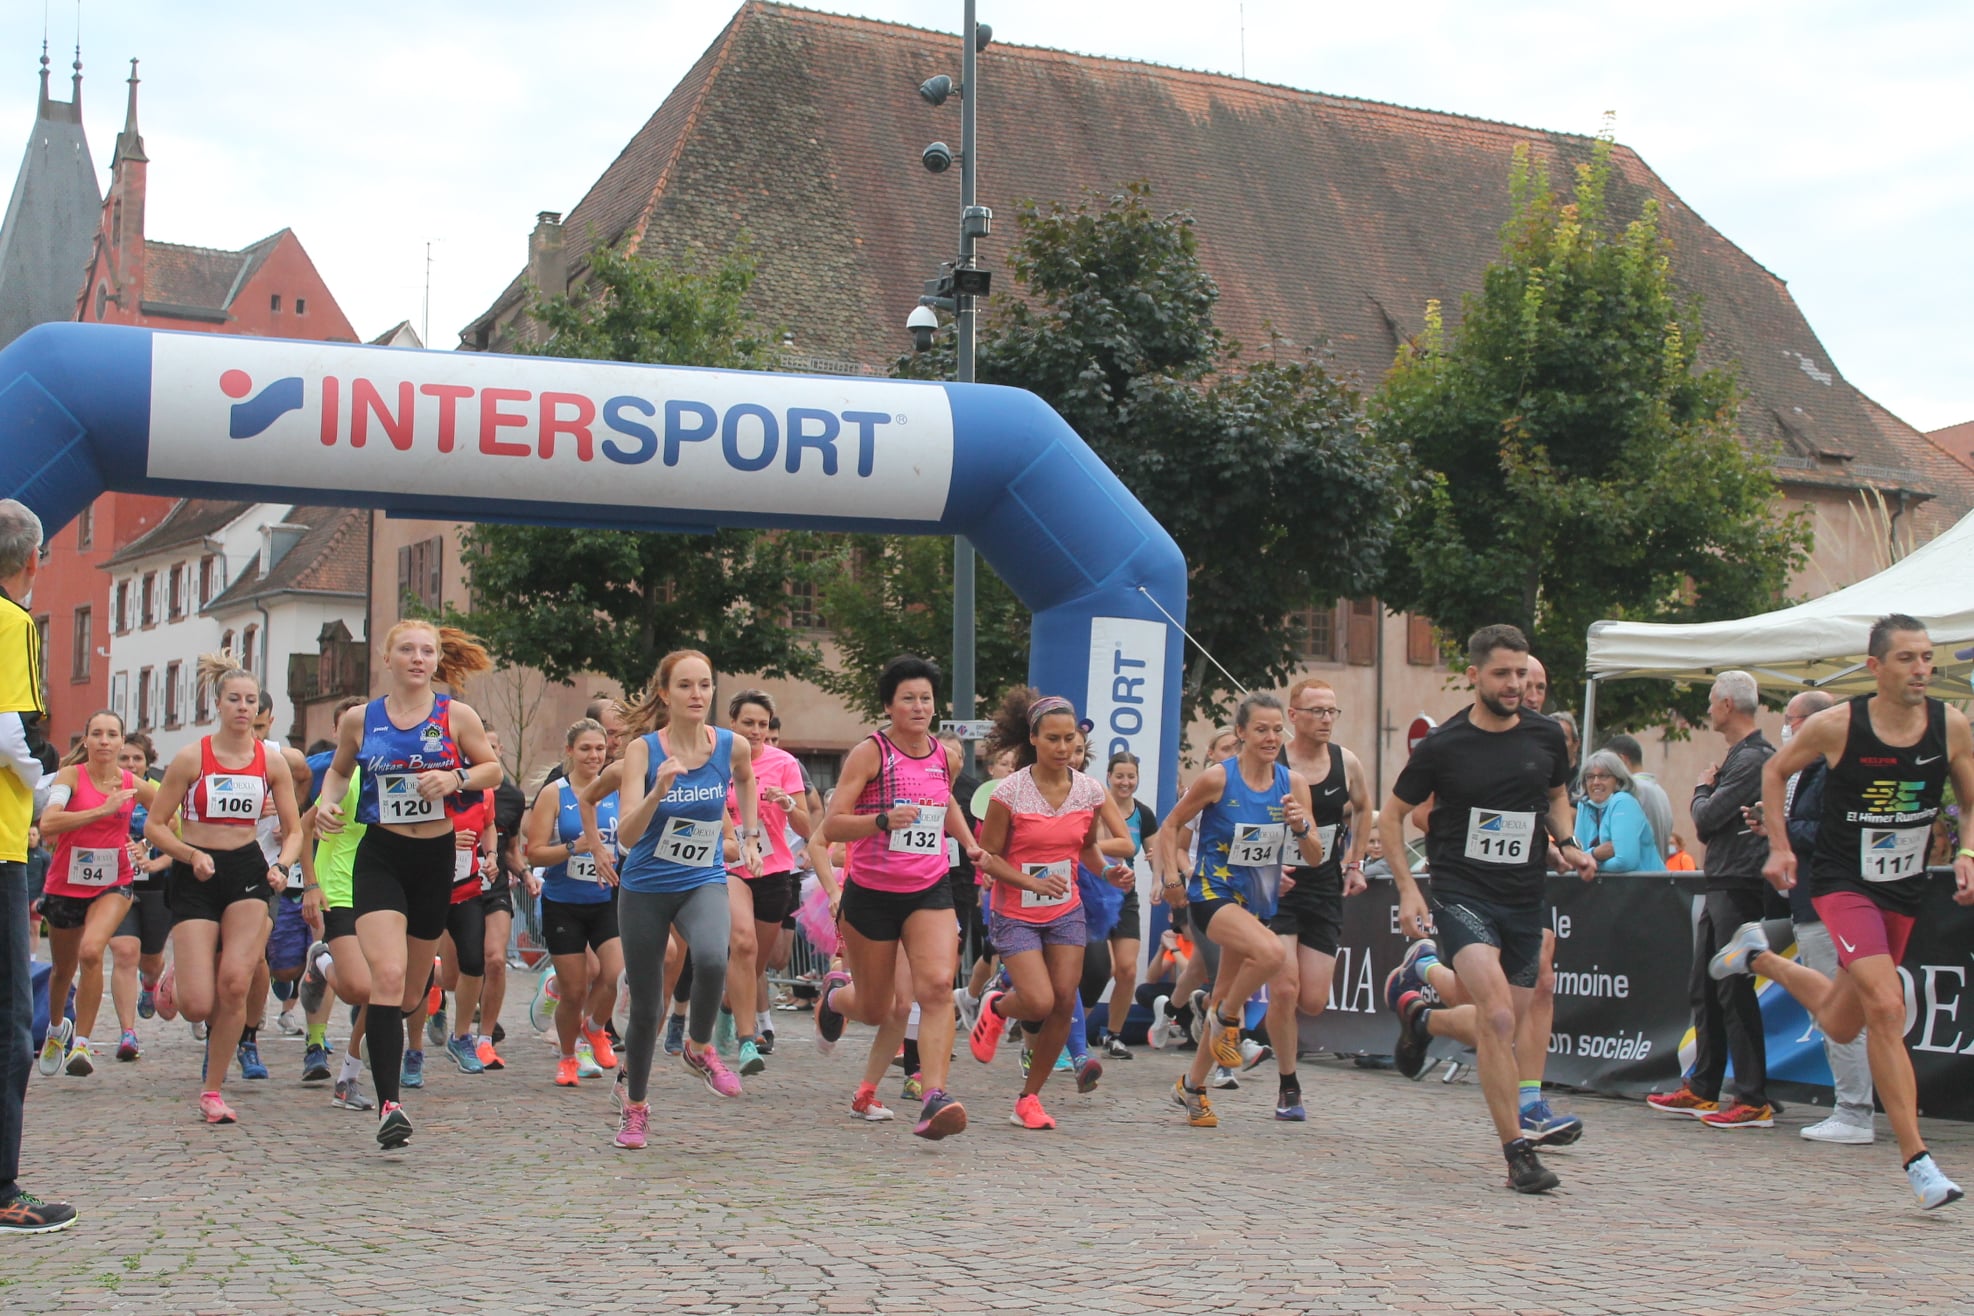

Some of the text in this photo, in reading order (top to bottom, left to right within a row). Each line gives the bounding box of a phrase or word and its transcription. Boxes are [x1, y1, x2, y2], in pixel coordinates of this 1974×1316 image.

[320, 375, 892, 478] INTERSPORT
[217, 797, 254, 813] 106
[391, 799, 433, 817] 120
[903, 830, 936, 848] 132
[1480, 838, 1522, 857] 116
[670, 842, 709, 861] 107
[1241, 846, 1272, 861] 134
[1875, 853, 1915, 875] 117
[83, 867, 103, 881] 94
[1578, 1030, 1652, 1061] sociale
